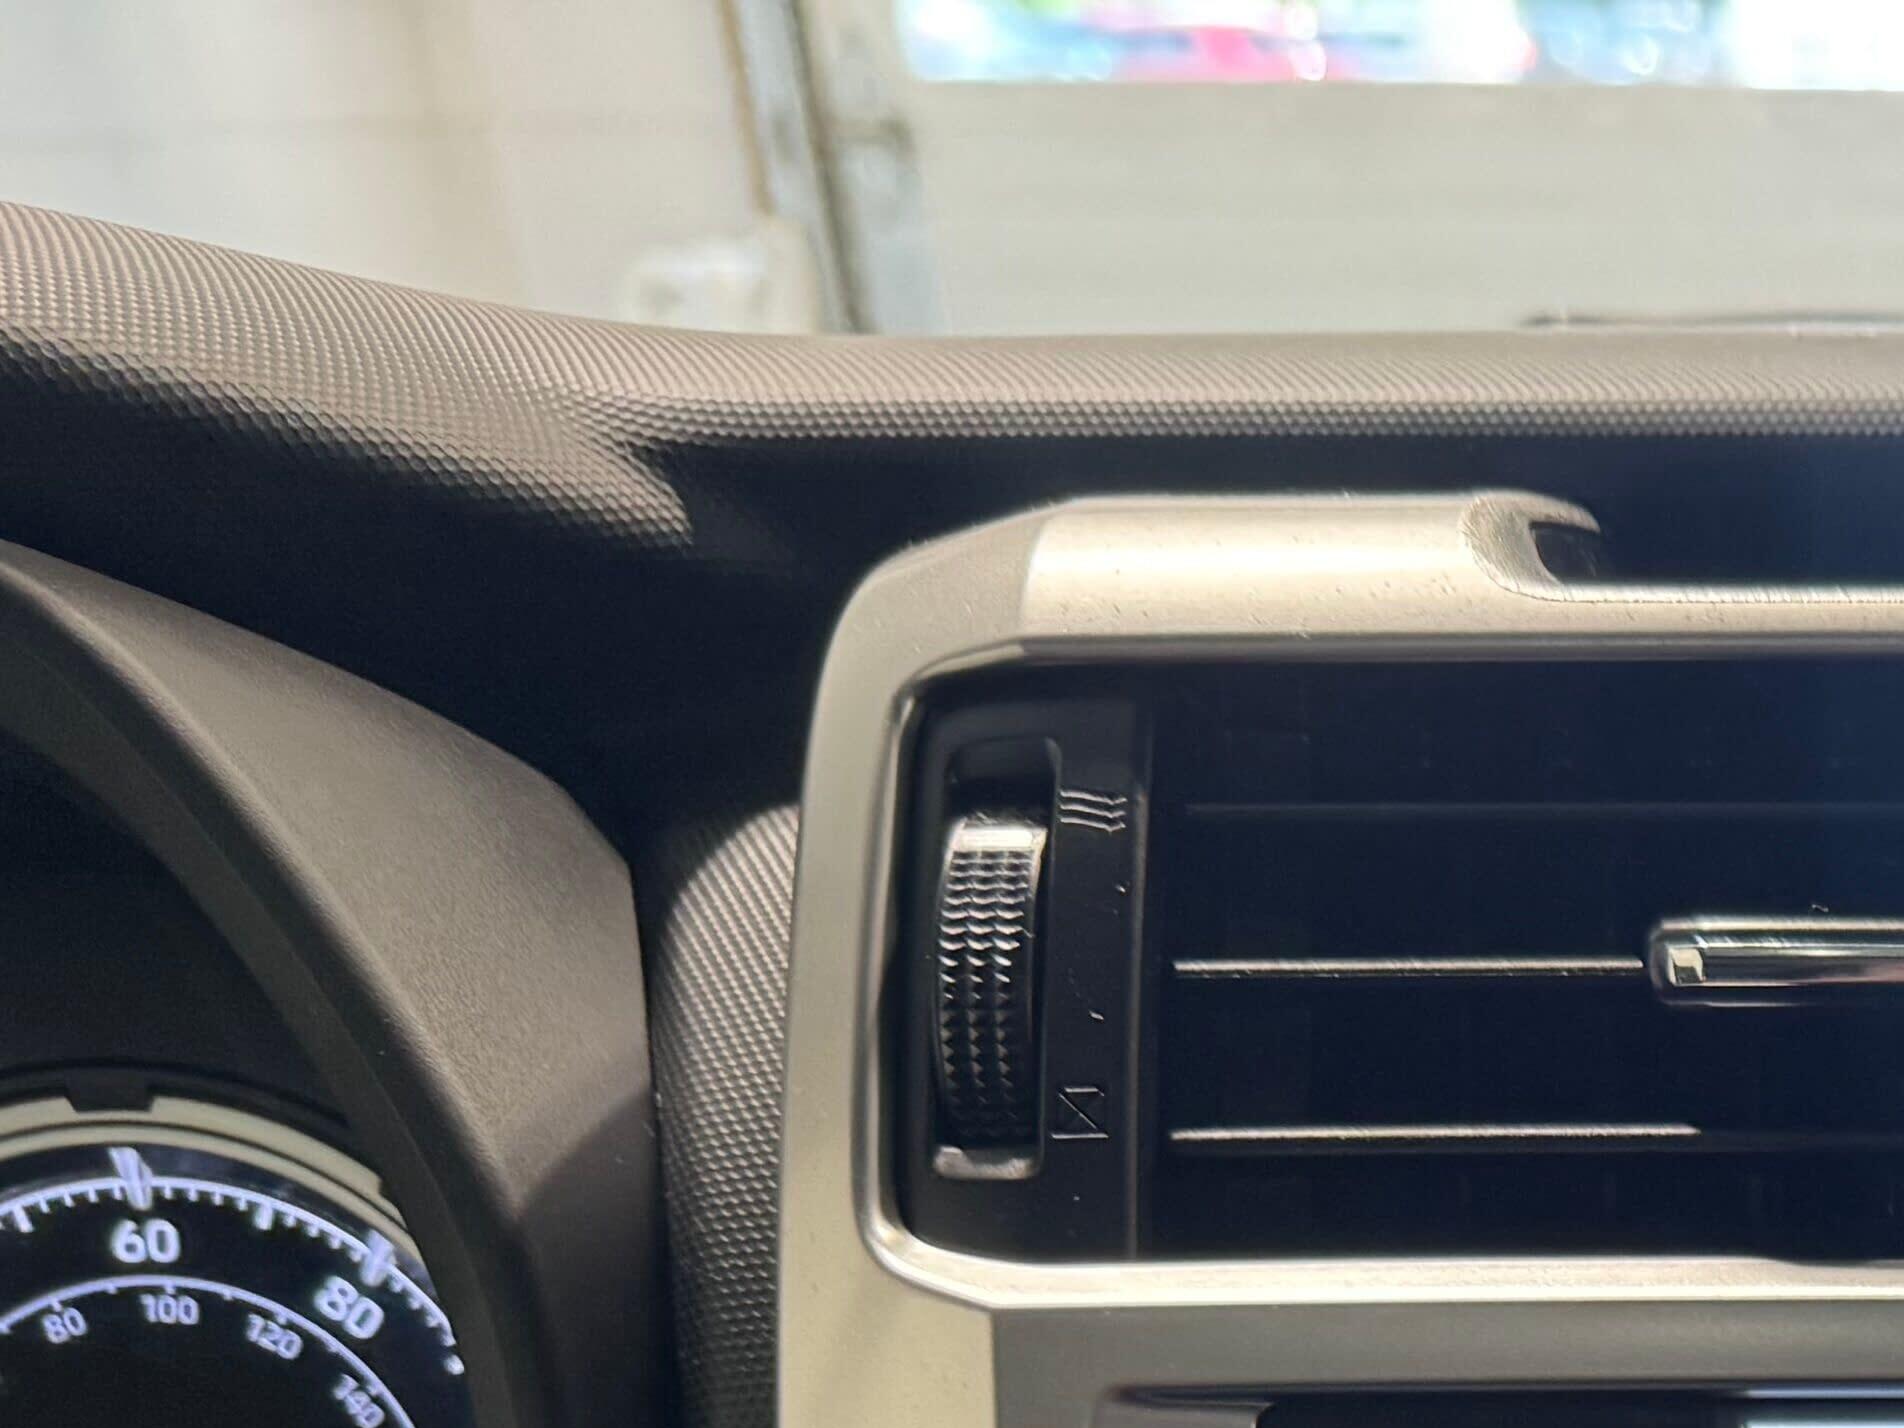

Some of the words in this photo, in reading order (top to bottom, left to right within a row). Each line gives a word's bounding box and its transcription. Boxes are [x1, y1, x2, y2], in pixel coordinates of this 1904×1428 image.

[112, 1220, 180, 1263] 60
[42, 1307, 88, 1345] 80
[141, 1295, 199, 1326] 100
[316, 1276, 384, 1340] 80
[246, 1314, 302, 1359] 120
